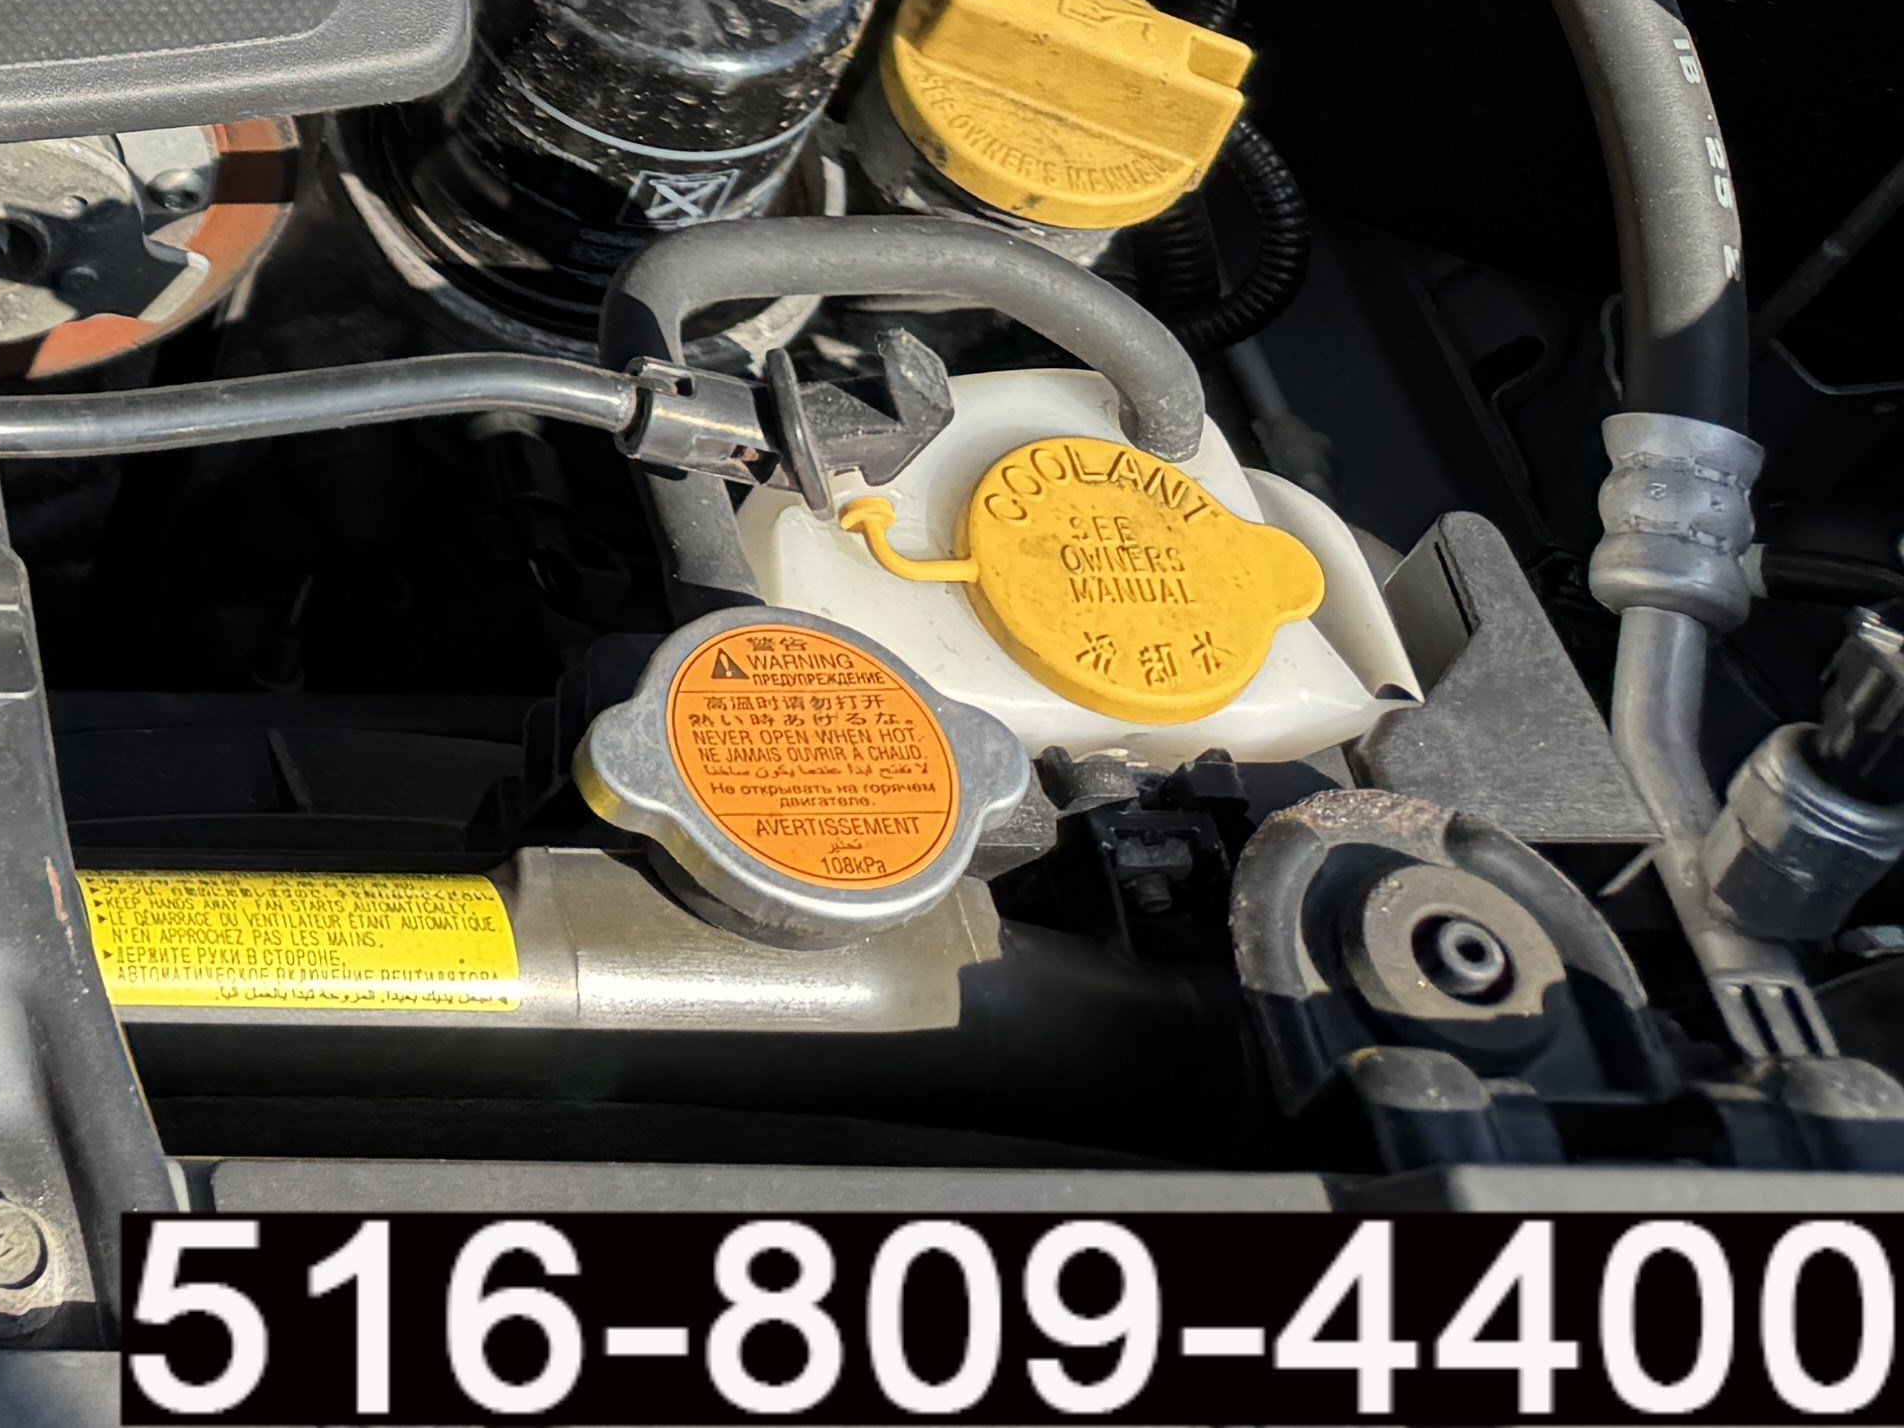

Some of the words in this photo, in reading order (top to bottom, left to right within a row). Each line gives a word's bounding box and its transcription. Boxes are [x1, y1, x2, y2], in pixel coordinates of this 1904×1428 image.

[1704, 136, 1734, 209] 25
[984, 443, 1220, 523] COOLANT
[1069, 515, 1133, 546] SEE
[1060, 544, 1186, 575] OWNERS
[1070, 577, 1196, 604] MANUAL
[747, 653, 855, 671] WARNING
[752, 672, 886, 688] ПРЕДУПРЕЖДЕНИЕ
[693, 729, 754, 746] NEVER
[759, 729, 809, 745] OPEN
[817, 728, 873, 745] WHEN
[698, 747, 721, 763] NE
[725, 746, 782, 763] JAMAIS
[787, 745, 847, 762] OUVRIR
[756, 816, 920, 837] AVERTISSEMENT
[821, 856, 888, 875] 108kPa
[106, 897, 142, 910] KEEP
[150, 898, 195, 910] HANDS
[256, 897, 283, 911] FAN
[292, 899, 345, 913] STARTS
[110, 912, 127, 925] LE
[220, 912, 238, 925] DU
[242, 910, 340, 929] VENTILATEUR
[112, 928, 151, 944] N'EN
[160, 928, 243, 945] APPROCHEZ
[253, 929, 282, 946] PAS
[291, 930, 320, 946] LES
[197, 947, 241, 966] РУКИ
